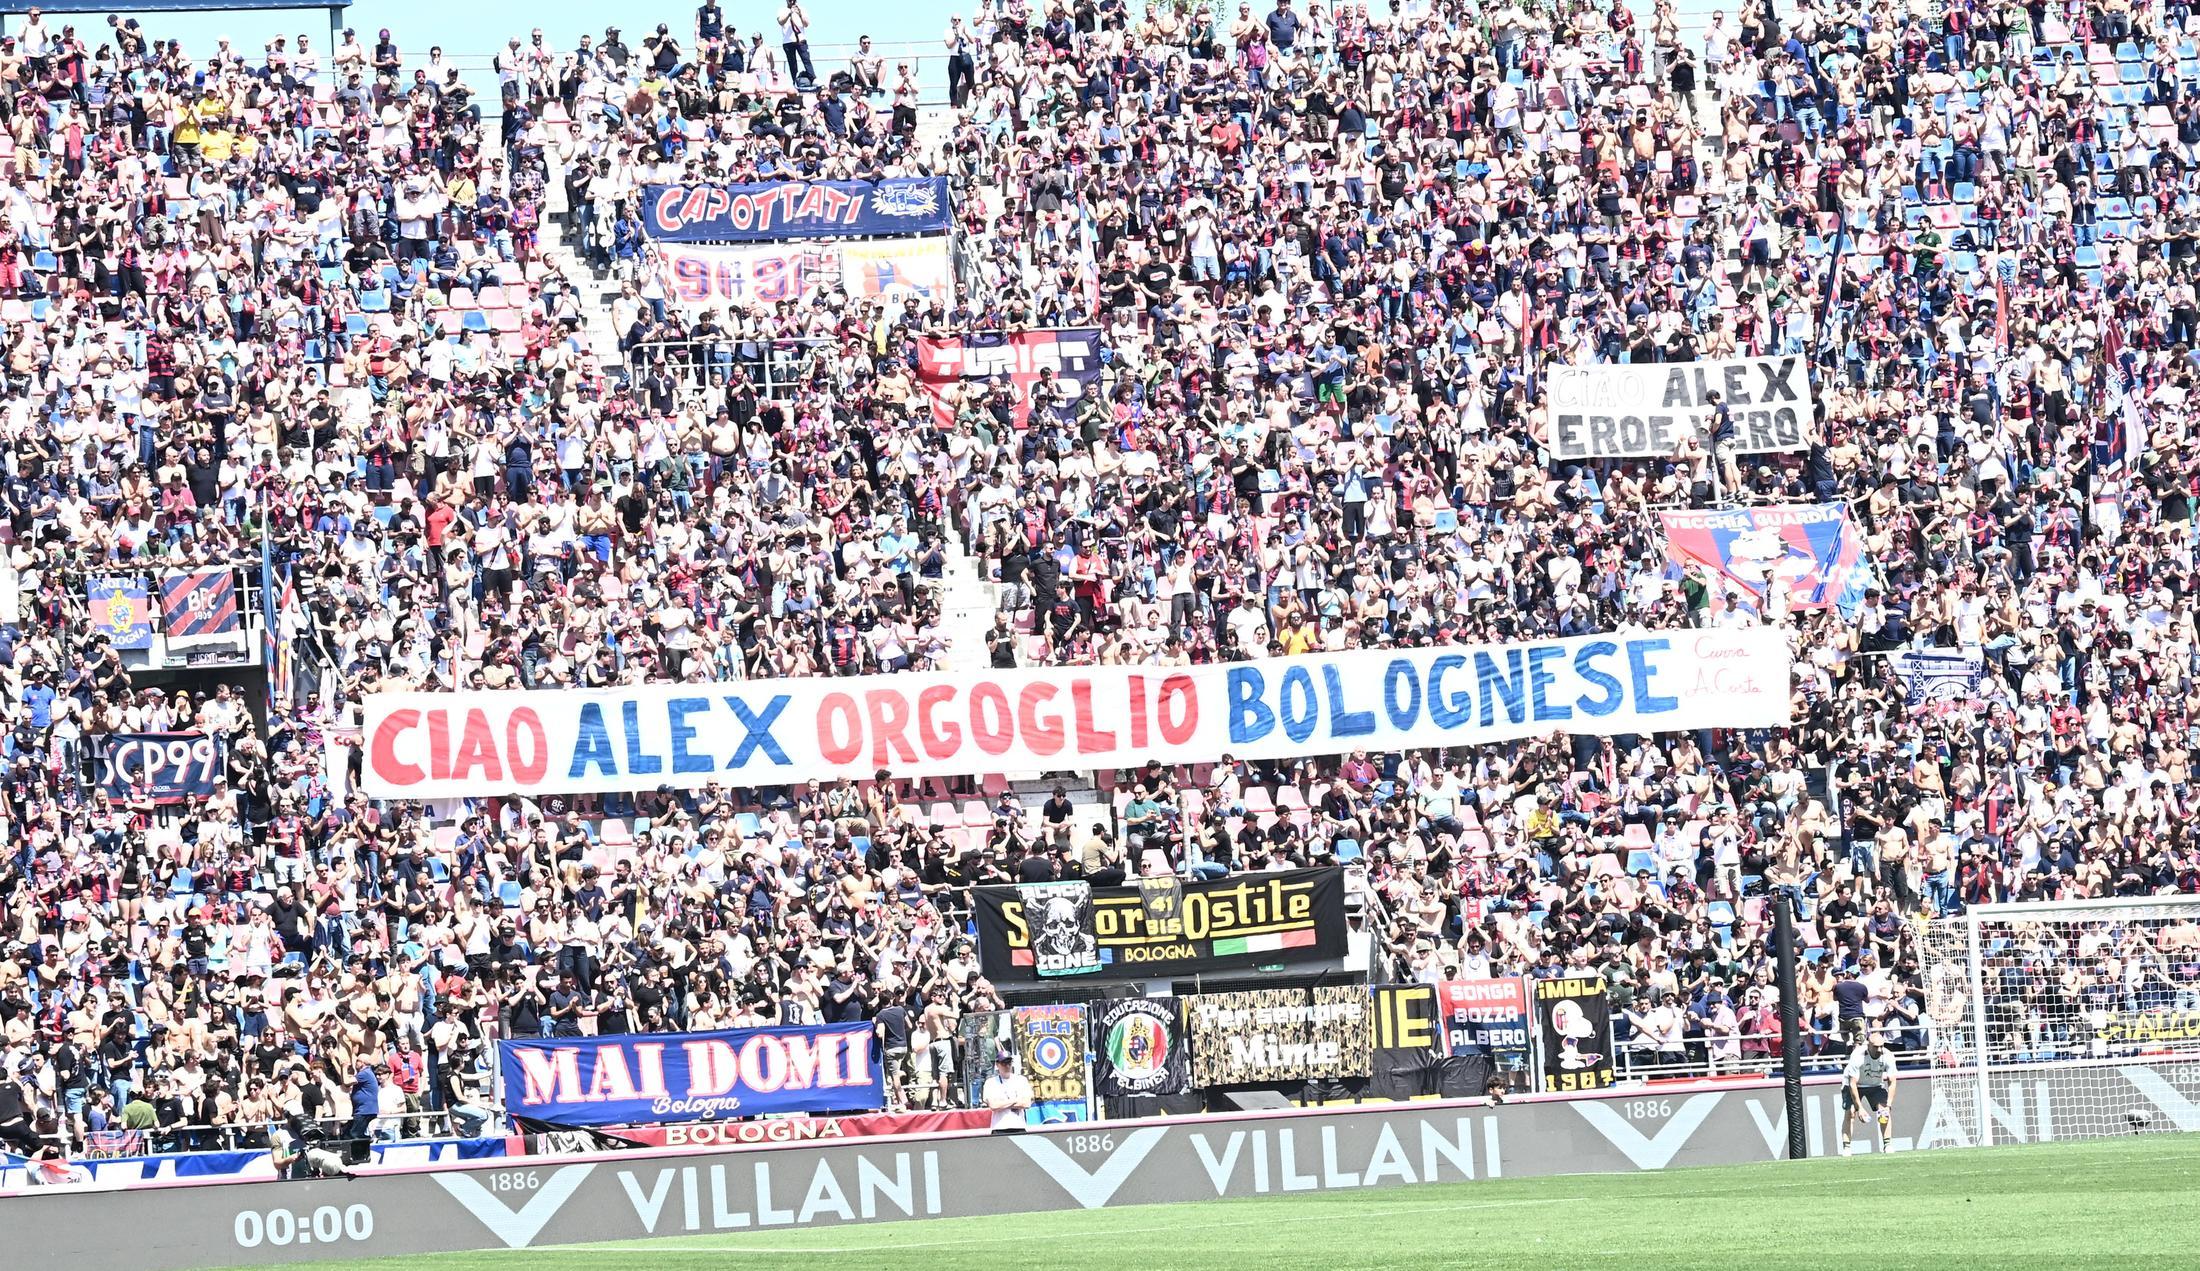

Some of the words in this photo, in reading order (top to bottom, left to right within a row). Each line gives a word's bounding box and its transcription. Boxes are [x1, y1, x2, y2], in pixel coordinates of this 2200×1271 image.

[656, 184, 865, 231] CAPOTTATI
[1554, 369, 1645, 408] CIAO
[1662, 357, 1798, 408] ALEX
[1558, 415, 1675, 455] EROE
[1667, 514, 1751, 529] VECCHIA
[1754, 509, 1843, 527] GUARDIA
[188, 588, 217, 611] BFC
[100, 628, 147, 645] LOGNA
[1695, 636, 1750, 659] Curva
[371, 706, 548, 785] CIAO
[568, 695, 793, 778] ALEX
[816, 672, 1199, 771] ORGOGLIO
[1227, 638, 1679, 744] BOLOGNESE
[1021, 883, 1089, 899] BLACK
[1001, 902, 1144, 947] Sor
[1183, 879, 1312, 940] Ostile
[1150, 896, 1173, 911] 41
[1145, 917, 1182, 934] BIS
[1036, 952, 1098, 970] ZONE
[1124, 943, 1197, 962] BOLOGNA
[1450, 983, 1516, 1000] SONGA
[1102, 1000, 1175, 1027] EDUCAZIONE
[1200, 1004, 1250, 1028] Per
[1257, 1003, 1362, 1029] sempre
[1454, 1006, 1518, 1023] BOZZA
[1027, 1020, 1071, 1035] FILA
[1450, 1029, 1525, 1047] ALBERO
[1228, 1034, 1339, 1069] Mime
[514, 1041, 667, 1106] MAI
[684, 1030, 873, 1095] DOMI
[651, 1093, 740, 1119] Bologna
[1624, 1100, 1671, 1120] 1886
[665, 1117, 846, 1145] BOLOGNA
[1065, 1133, 1114, 1155] 1886
[1190, 1115, 1501, 1197] VILLANI
[488, 1170, 540, 1192] 1886
[617, 1150, 942, 1234] VILLANI
[234, 1203, 374, 1248] 00:00
